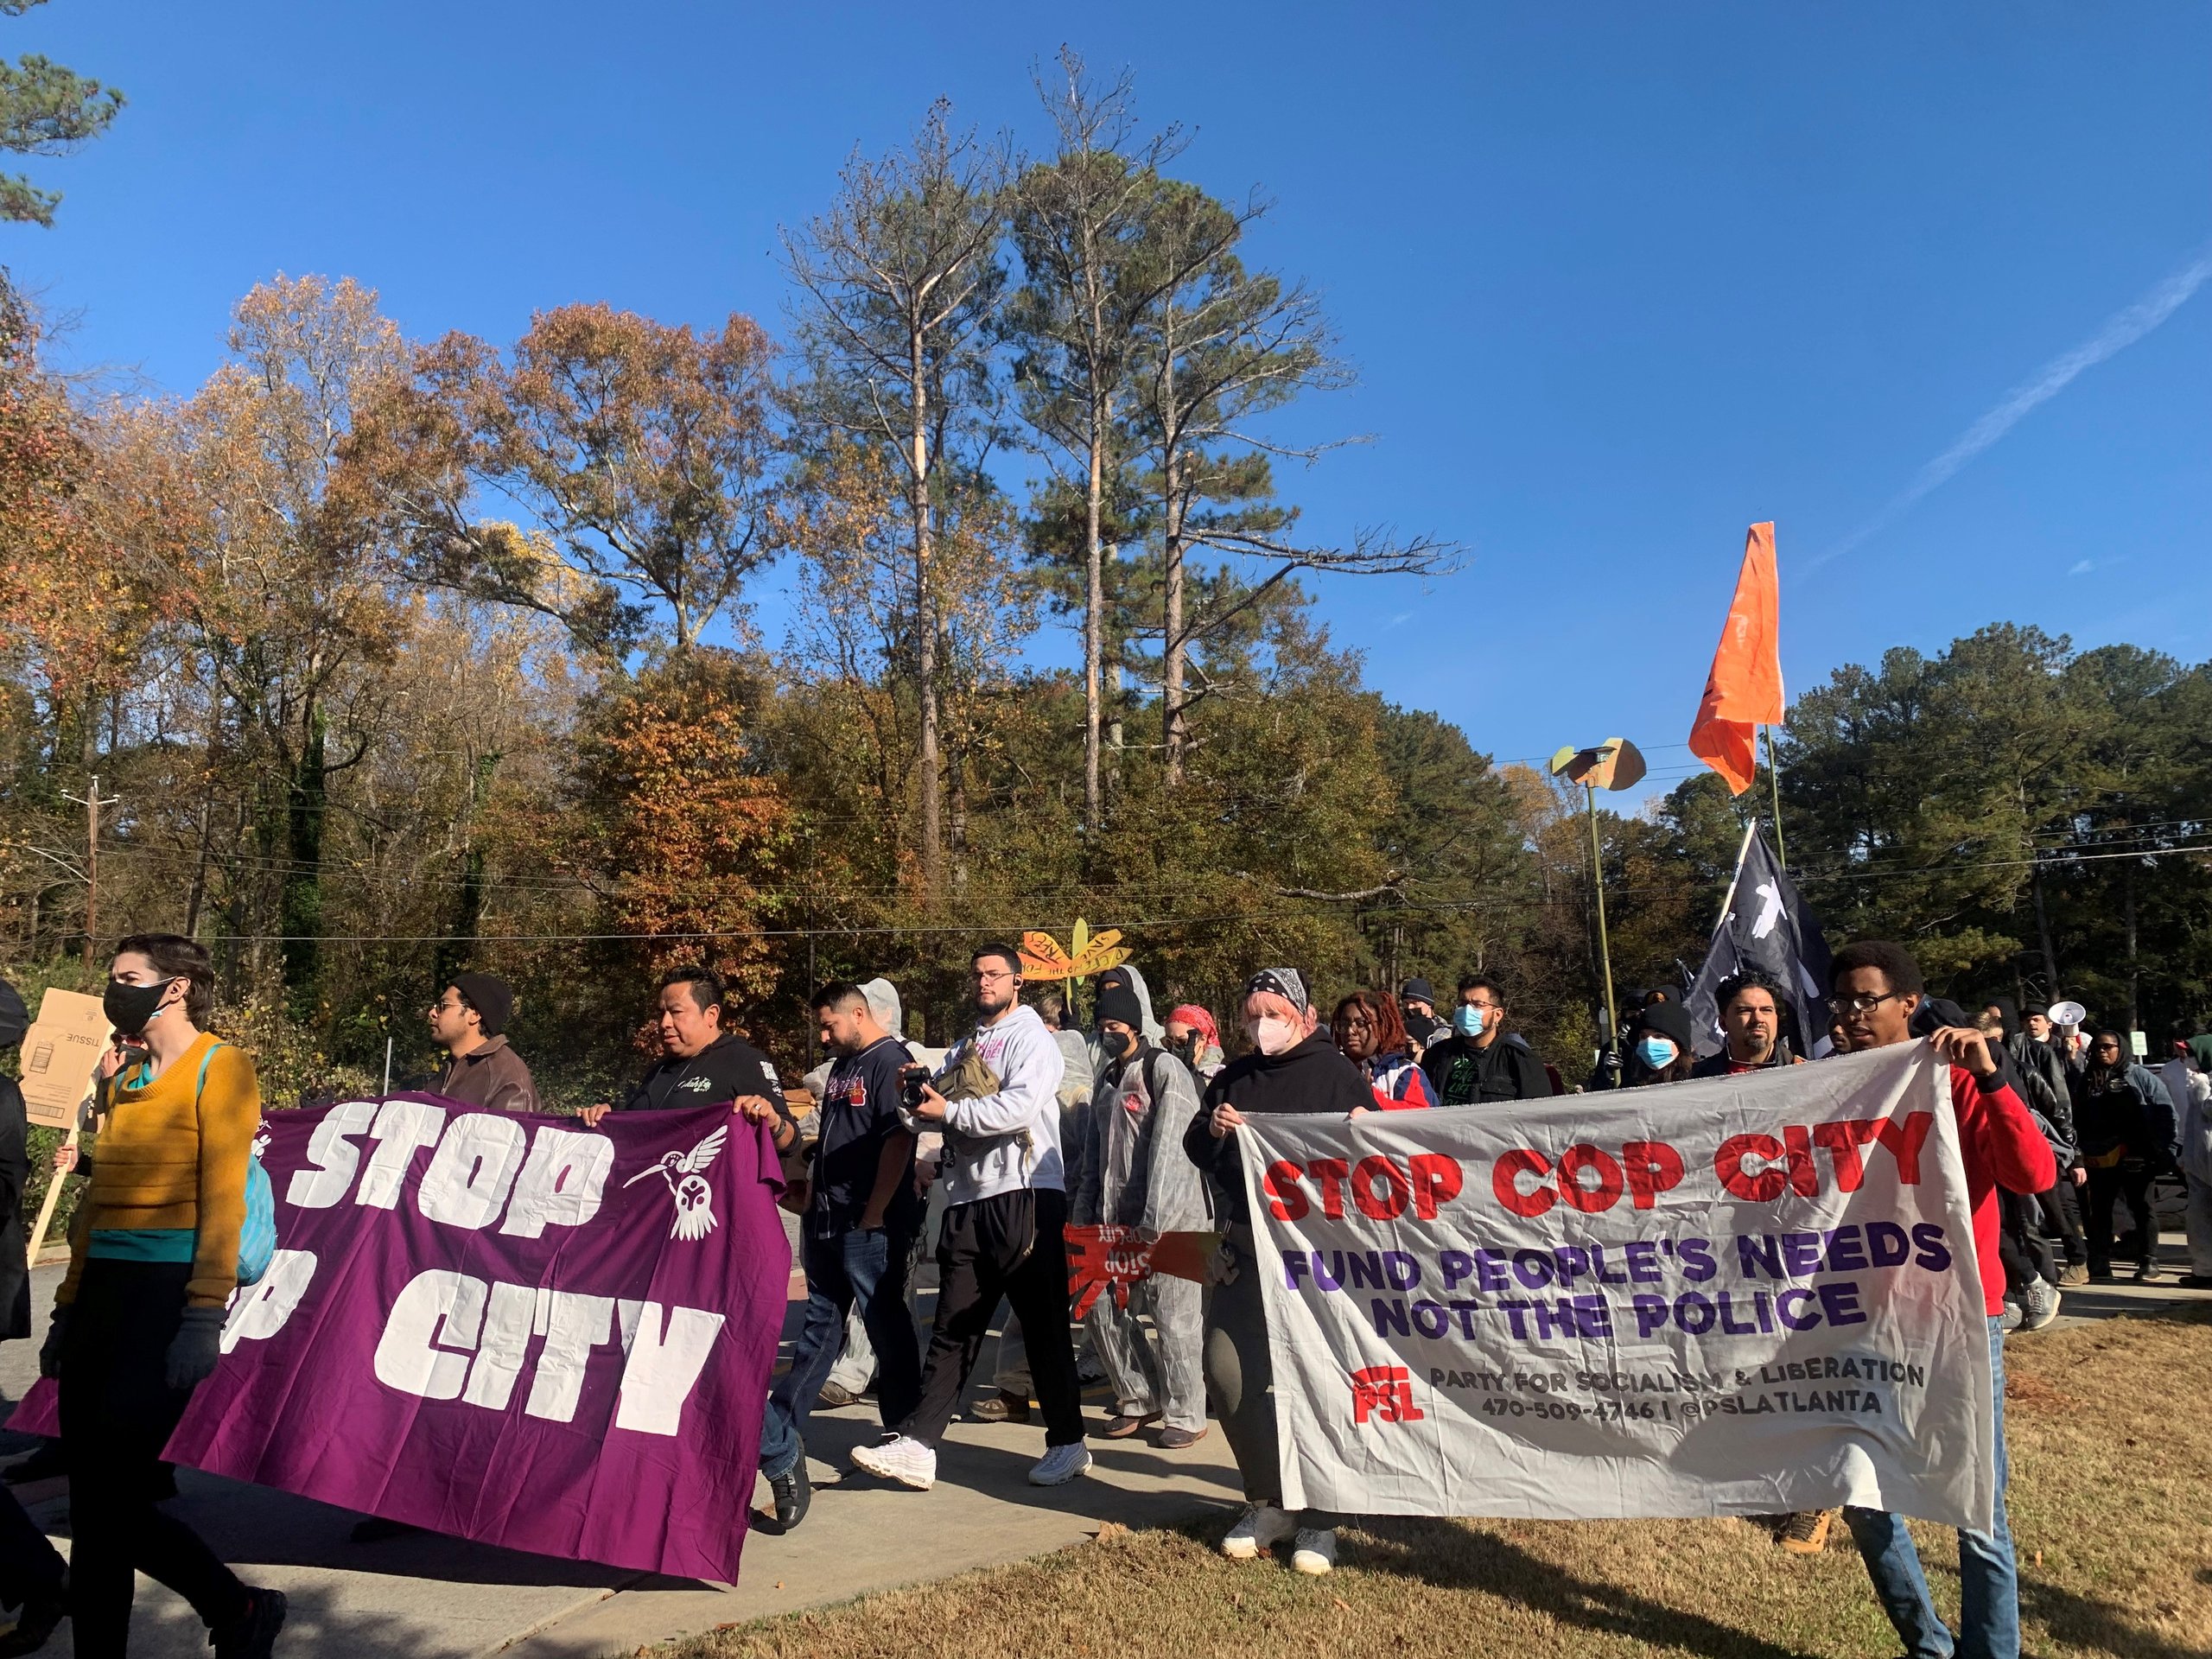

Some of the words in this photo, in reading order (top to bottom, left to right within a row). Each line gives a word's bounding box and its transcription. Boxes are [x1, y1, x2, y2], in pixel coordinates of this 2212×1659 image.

[1028, 932, 1062, 964] TREES
[1080, 936, 1109, 961] SAVE
[67, 1033, 99, 1047] TISSUE
[285, 1100, 614, 1239] STOP
[1263, 1154, 1463, 1221] STOP
[1492, 1141, 1684, 1217] COP
[1714, 1111, 1933, 1202] CITY
[1104, 1249, 1151, 1275] STOP
[1282, 1250, 1421, 1292] FUND
[1440, 1238, 1717, 1293] PEOPLE'S
[1738, 1221, 1952, 1280] NEEDS
[1372, 1298, 1478, 1341] NOT
[1497, 1294, 1613, 1340] THE
[1633, 1282, 1866, 1338] POLICE
[374, 1268, 726, 1436] CITY
[1430, 1368, 1507, 1392] PARTY
[1516, 1373, 1568, 1394] FOR
[1574, 1371, 1724, 1392] SOCIALISM
[1735, 1369, 1751, 1386] &
[1761, 1357, 1924, 1388] LIBERATION
[1352, 1381, 1424, 1424] PSL
[1482, 1398, 1655, 1421] 470-509-4746
[1680, 1389, 1882, 1417] @PSLATLANTA
